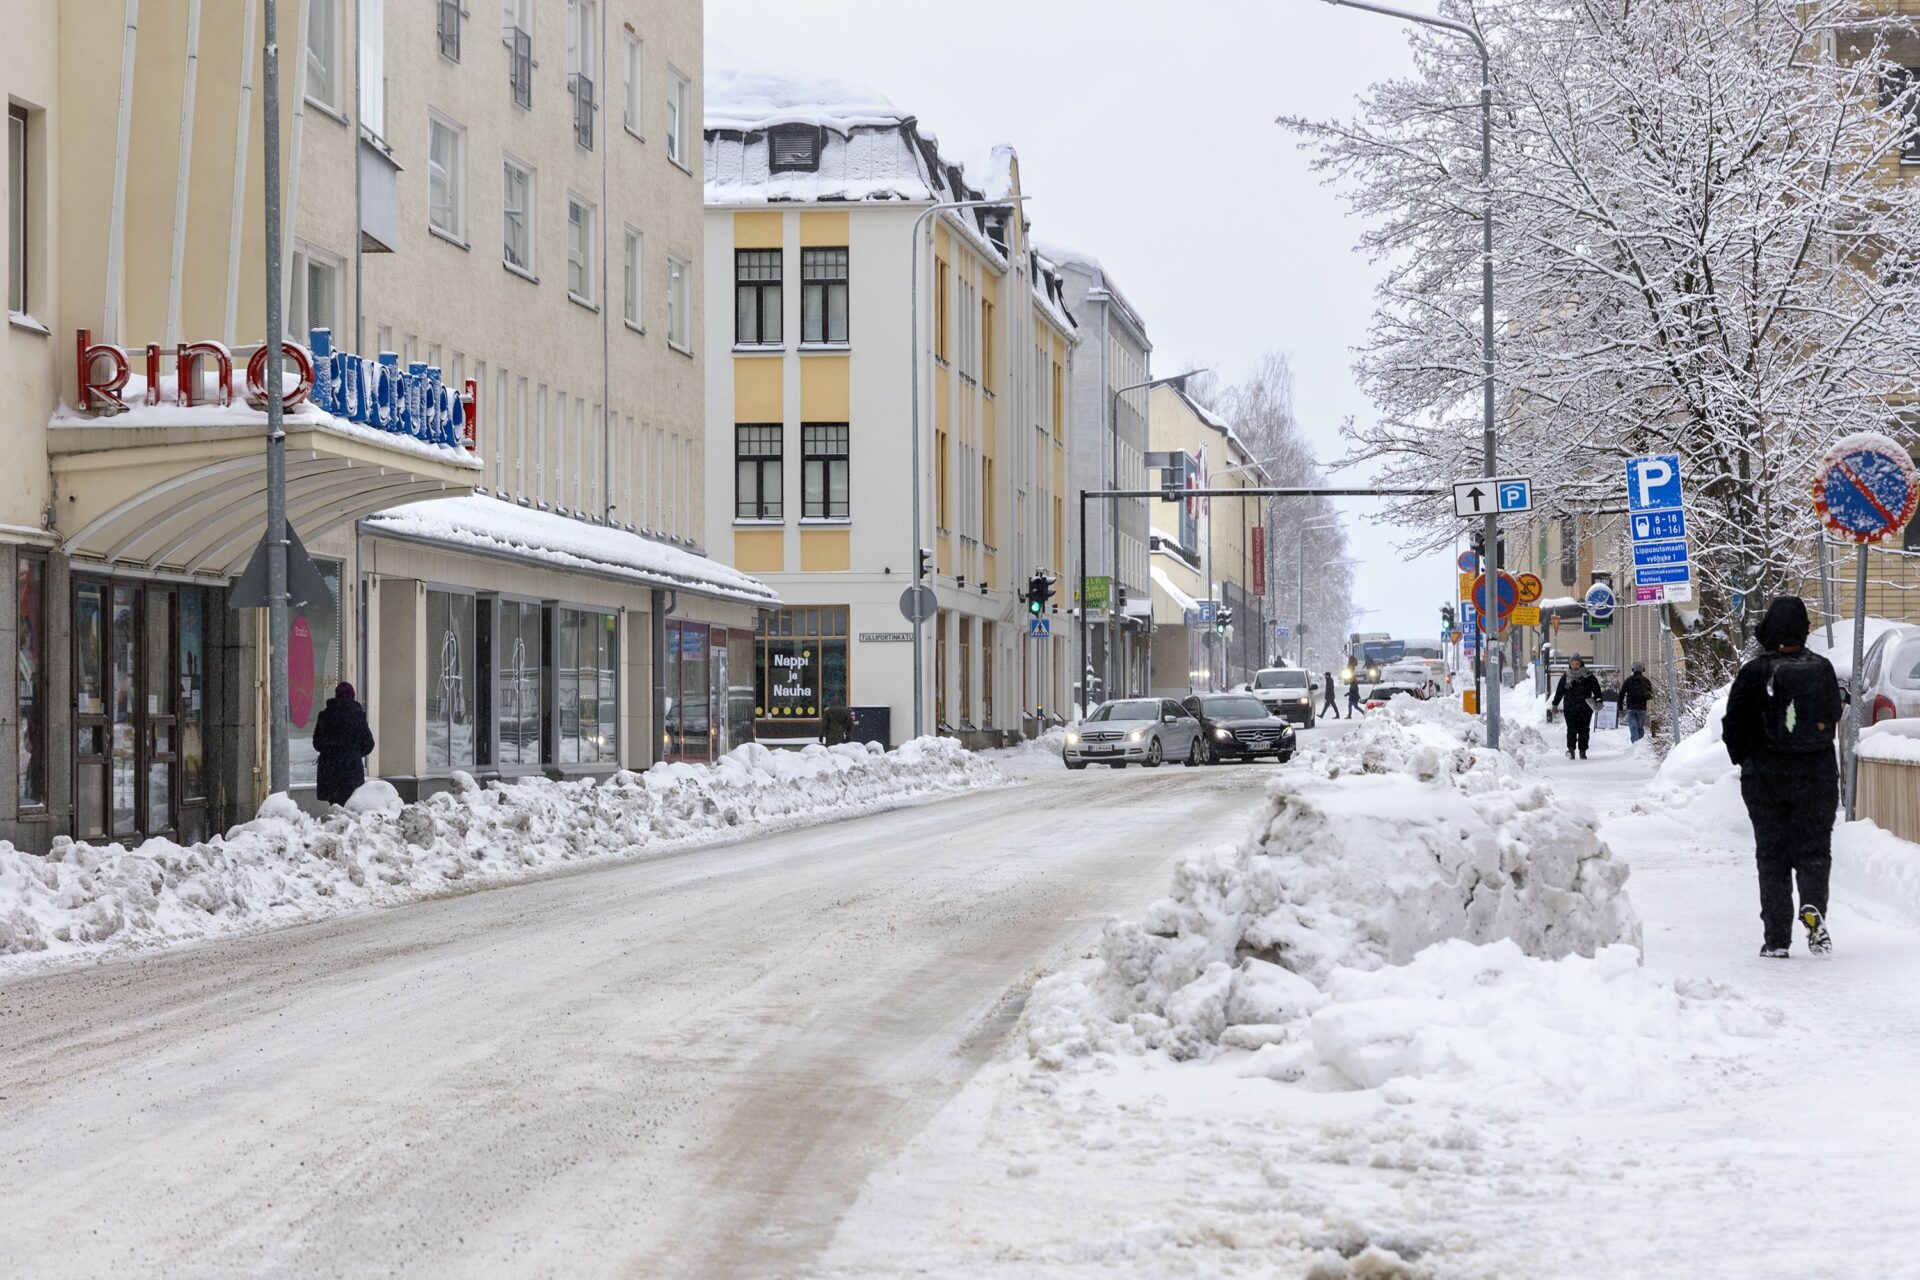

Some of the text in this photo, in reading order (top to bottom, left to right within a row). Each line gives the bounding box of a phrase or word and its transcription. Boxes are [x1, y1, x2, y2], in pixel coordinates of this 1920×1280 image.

[1638, 461, 1672, 507] P
[1507, 490, 1520, 507] P
[1635, 544, 1685, 555] Lippuautomaatti
[1646, 554, 1672, 563] vyöhyke
[774, 651, 810, 669] Nappi
[787, 670, 798, 683] ja
[773, 683, 812, 696] Nauha
